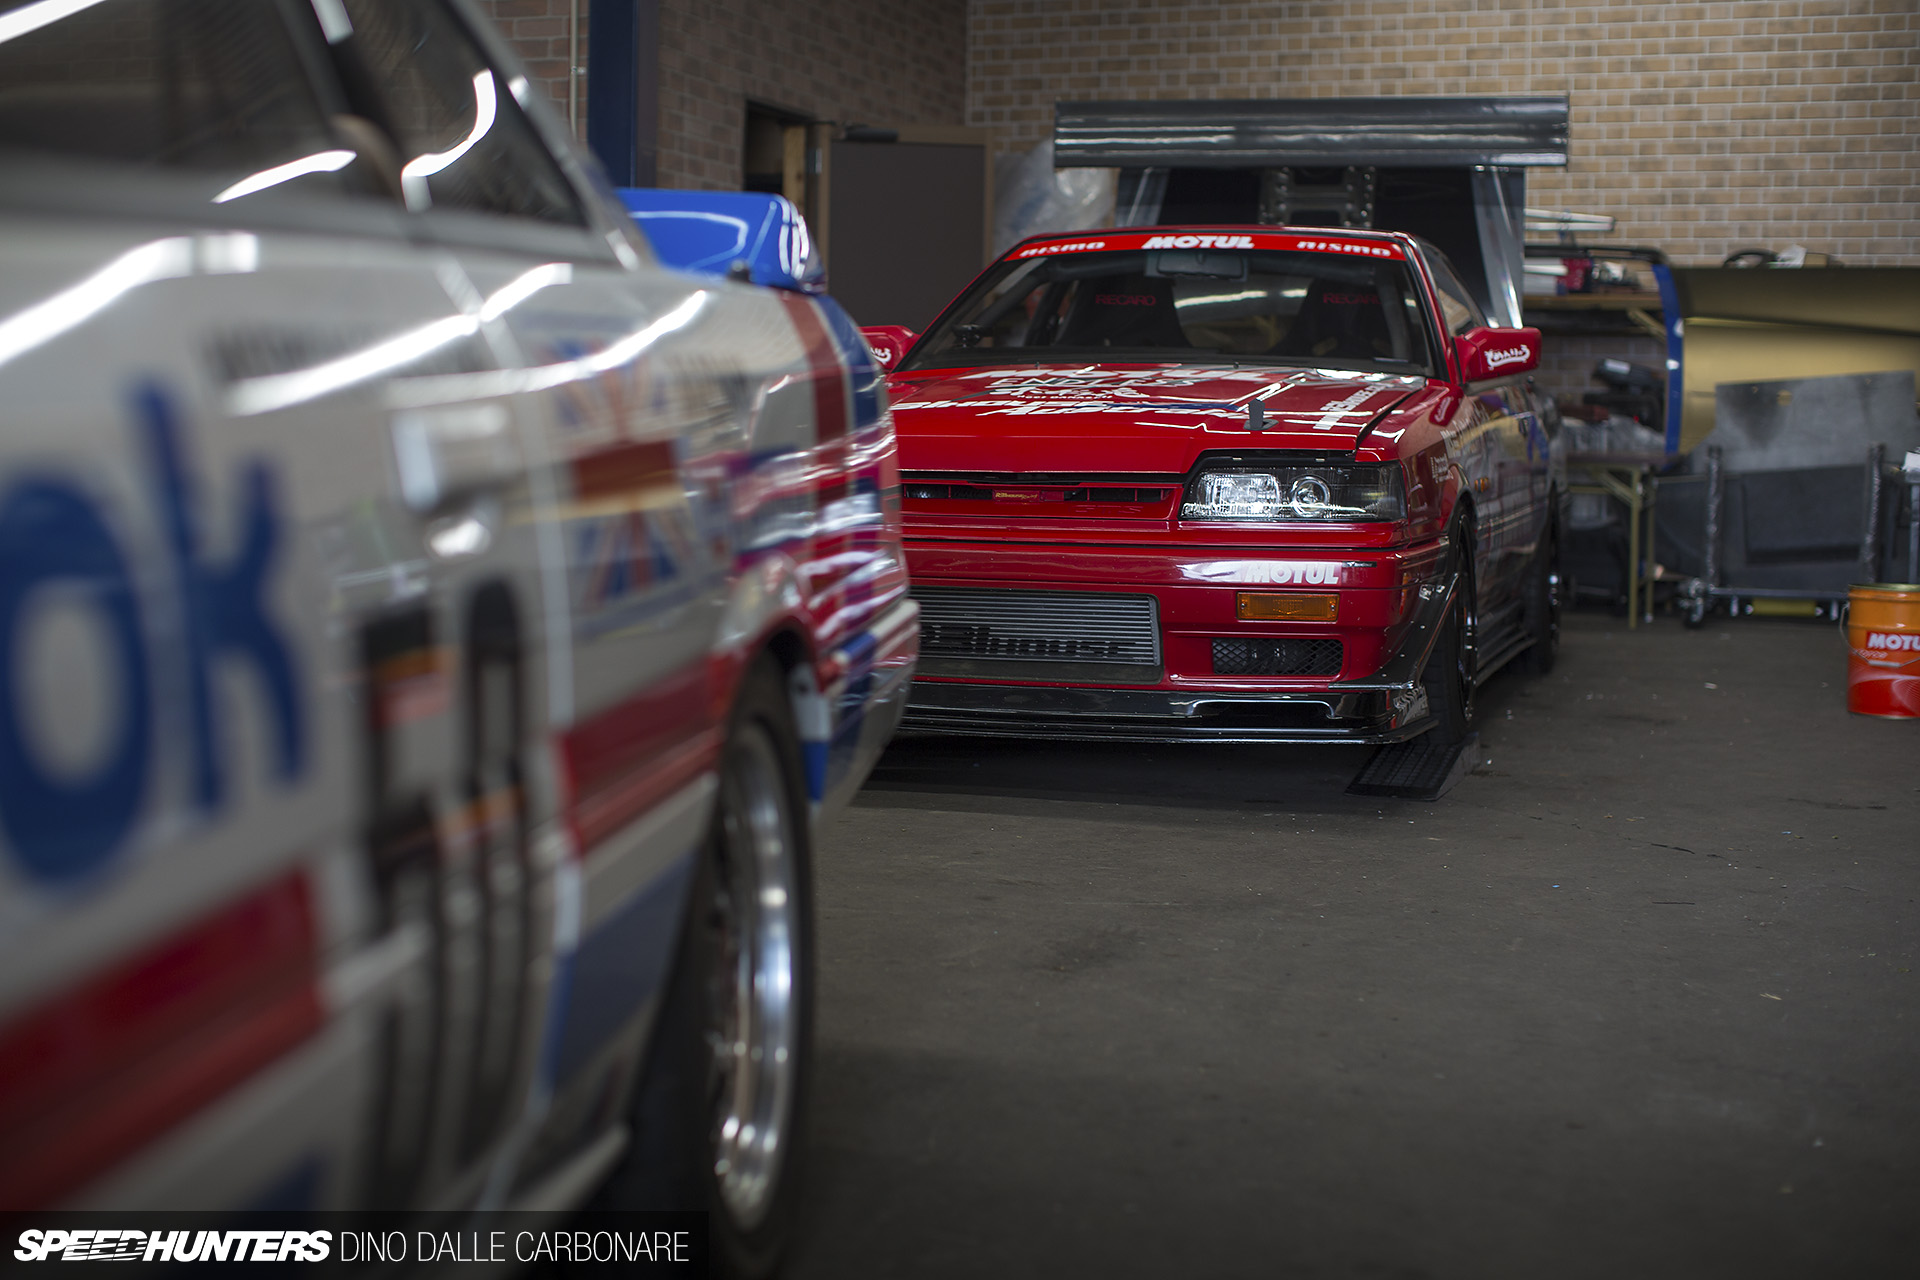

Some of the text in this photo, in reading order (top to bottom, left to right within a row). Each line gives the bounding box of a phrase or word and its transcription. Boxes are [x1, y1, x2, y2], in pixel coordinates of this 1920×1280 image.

[1141, 235, 1255, 249] MOTUL
[1095, 294, 1157, 306] RECARO
[957, 368, 1272, 382] MOTUL
[984, 377, 1196, 389] ENDLESS
[1243, 561, 1339, 585] MOTUL
